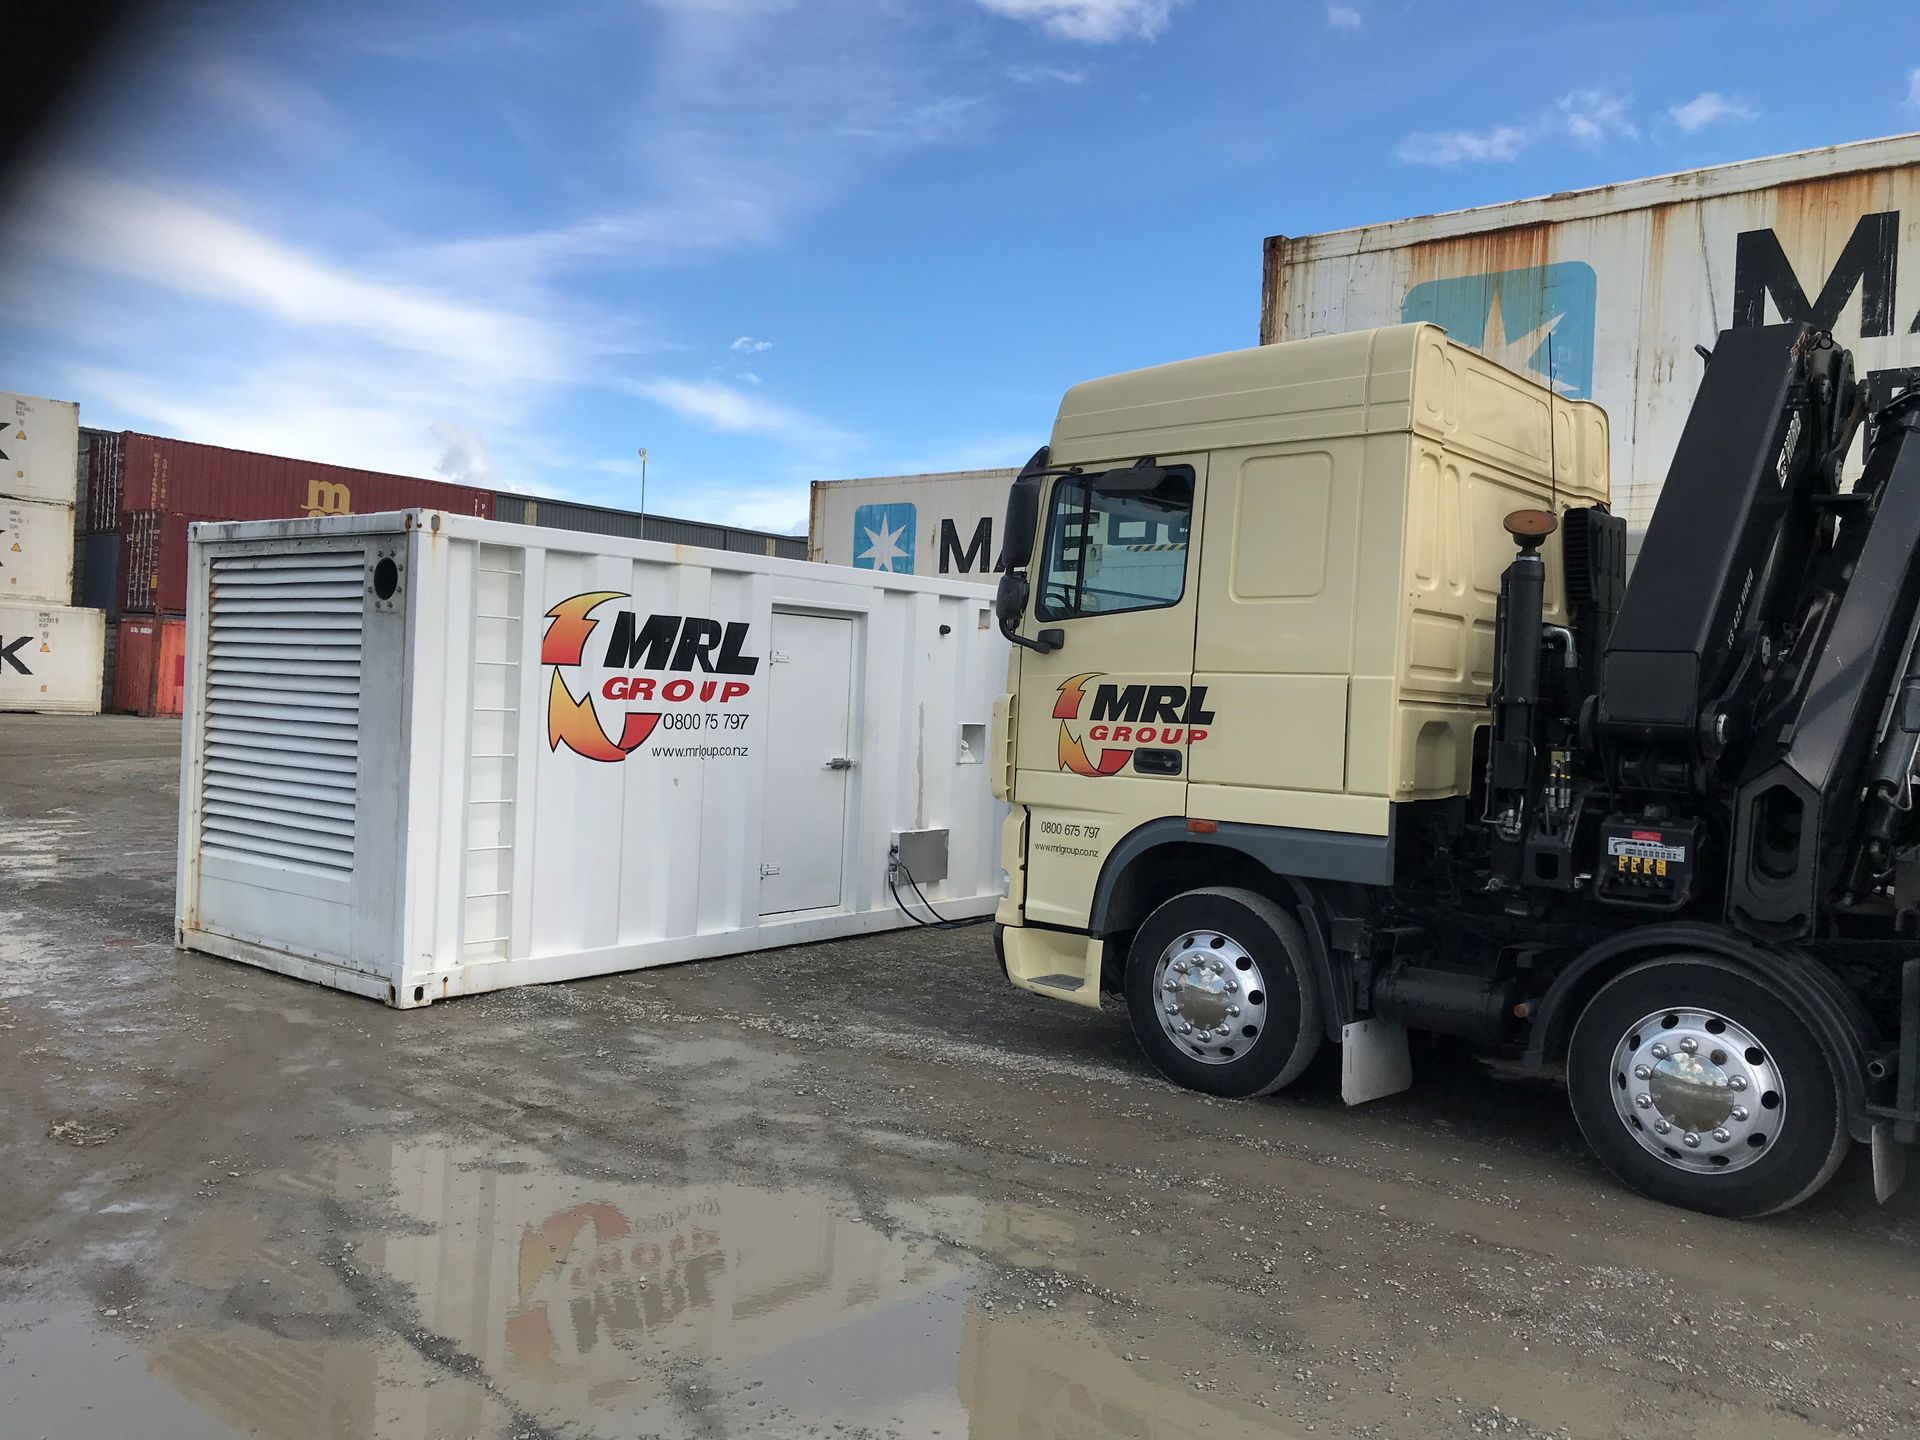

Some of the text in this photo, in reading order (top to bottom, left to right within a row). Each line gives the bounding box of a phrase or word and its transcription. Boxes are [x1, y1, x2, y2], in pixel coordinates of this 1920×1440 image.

[1733, 210, 1920, 339] M
[603, 611, 760, 675] MRL
[602, 676, 750, 703] GROUP
[1089, 684, 1215, 725] MRL
[663, 713, 700, 730] 0800
[723, 713, 750, 730] 797
[1089, 725, 1208, 745] GROUP
[1041, 821, 1100, 839] 0800 675 797
[1034, 843, 1099, 857] www.mrlgroup.co.nz
